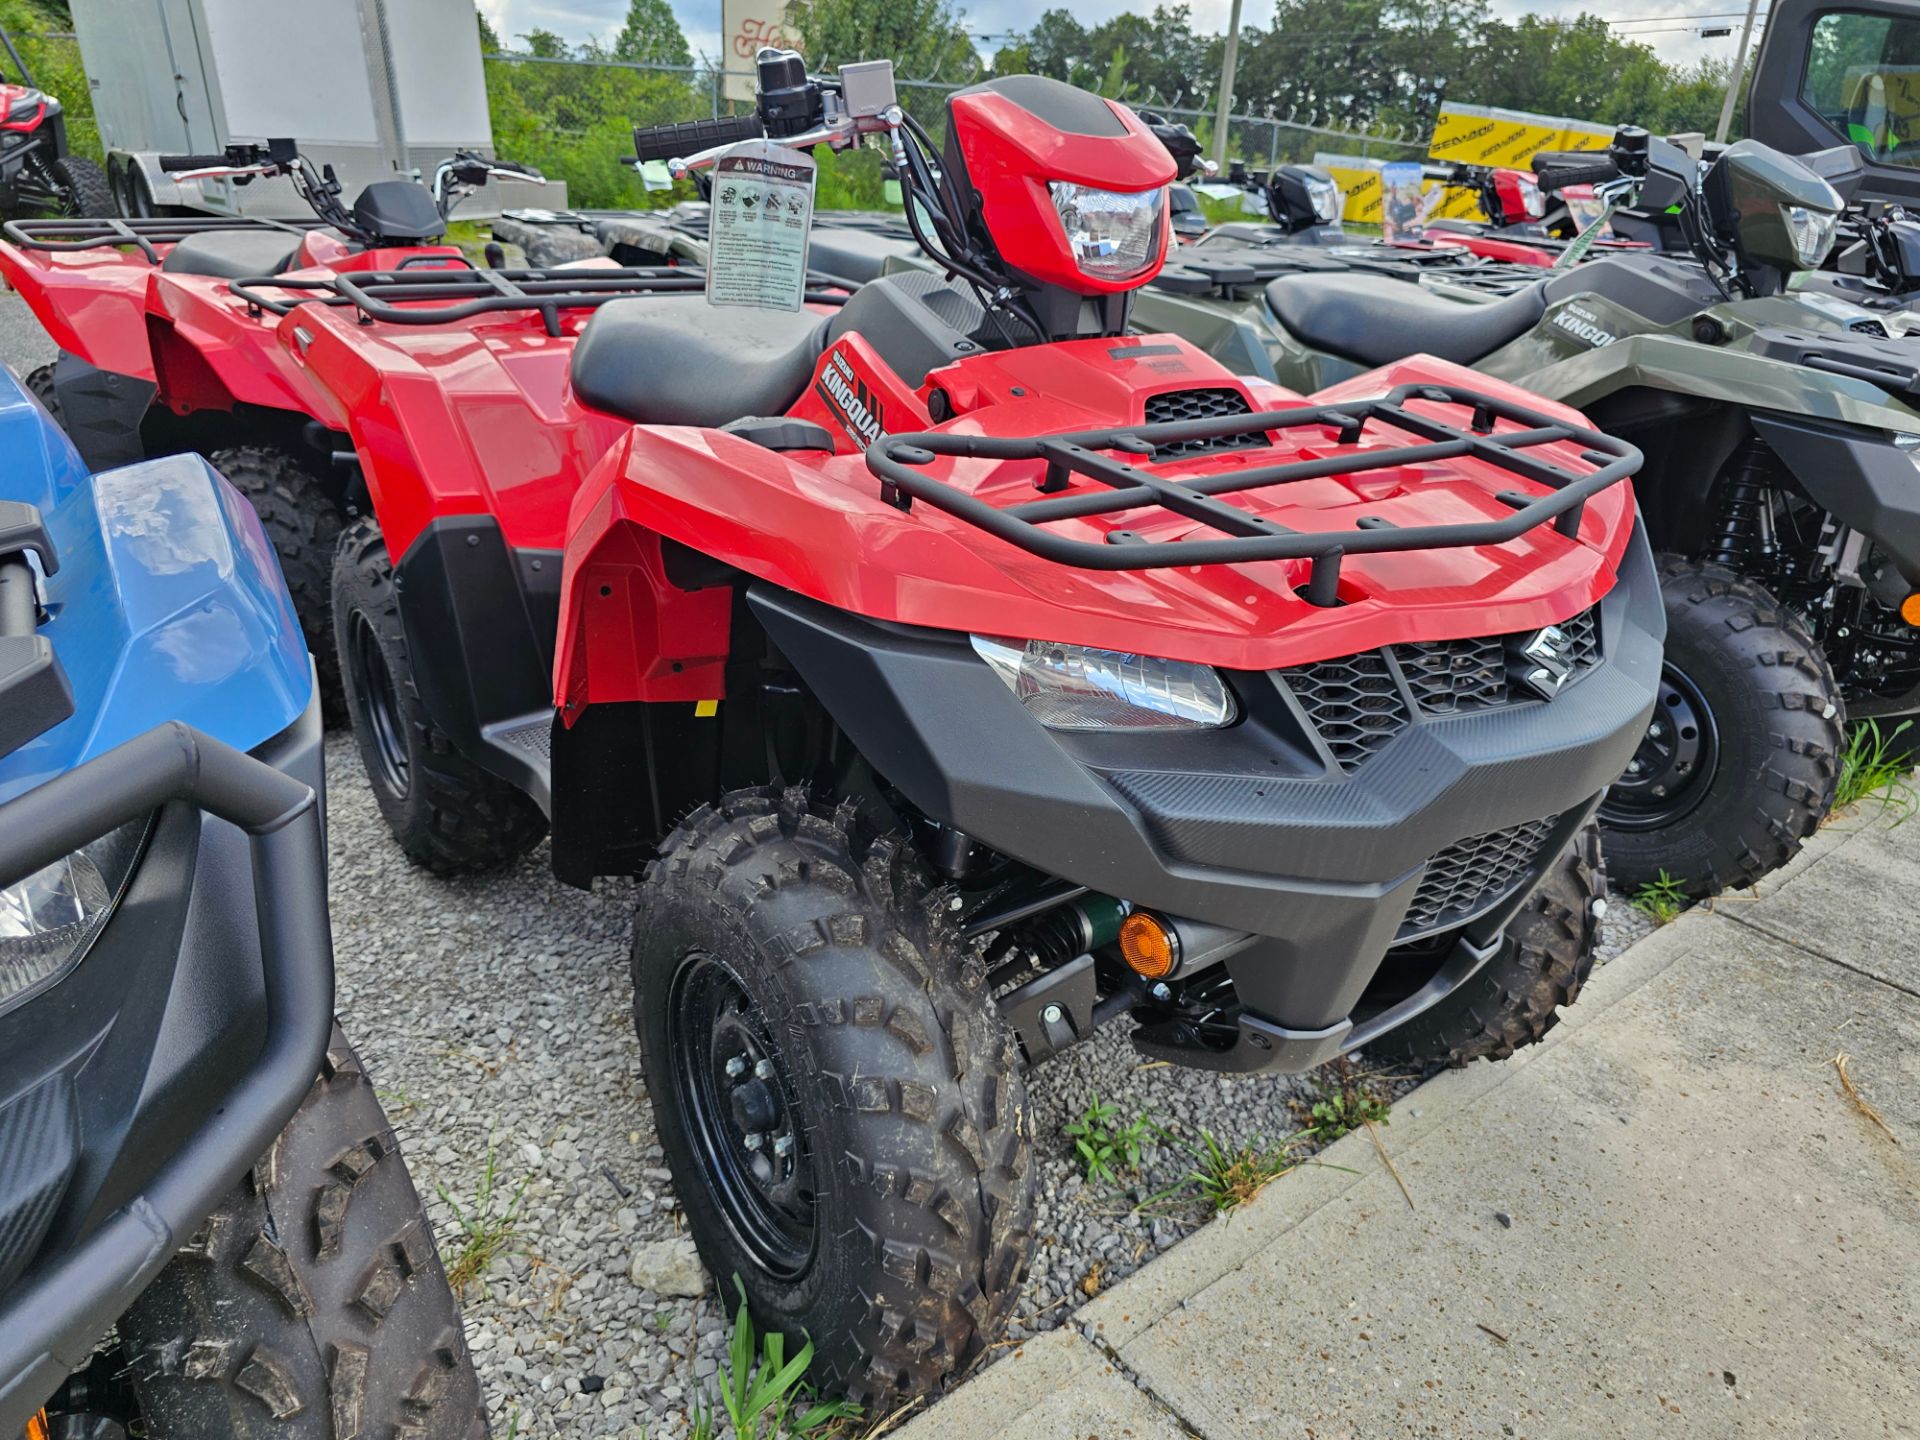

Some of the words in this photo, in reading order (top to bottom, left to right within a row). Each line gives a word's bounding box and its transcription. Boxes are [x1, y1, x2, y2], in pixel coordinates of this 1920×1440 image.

[746, 161, 796, 179] WARNING
[1568, 303, 1598, 322] SUZUKI
[821, 362, 889, 442] KINGQUA
